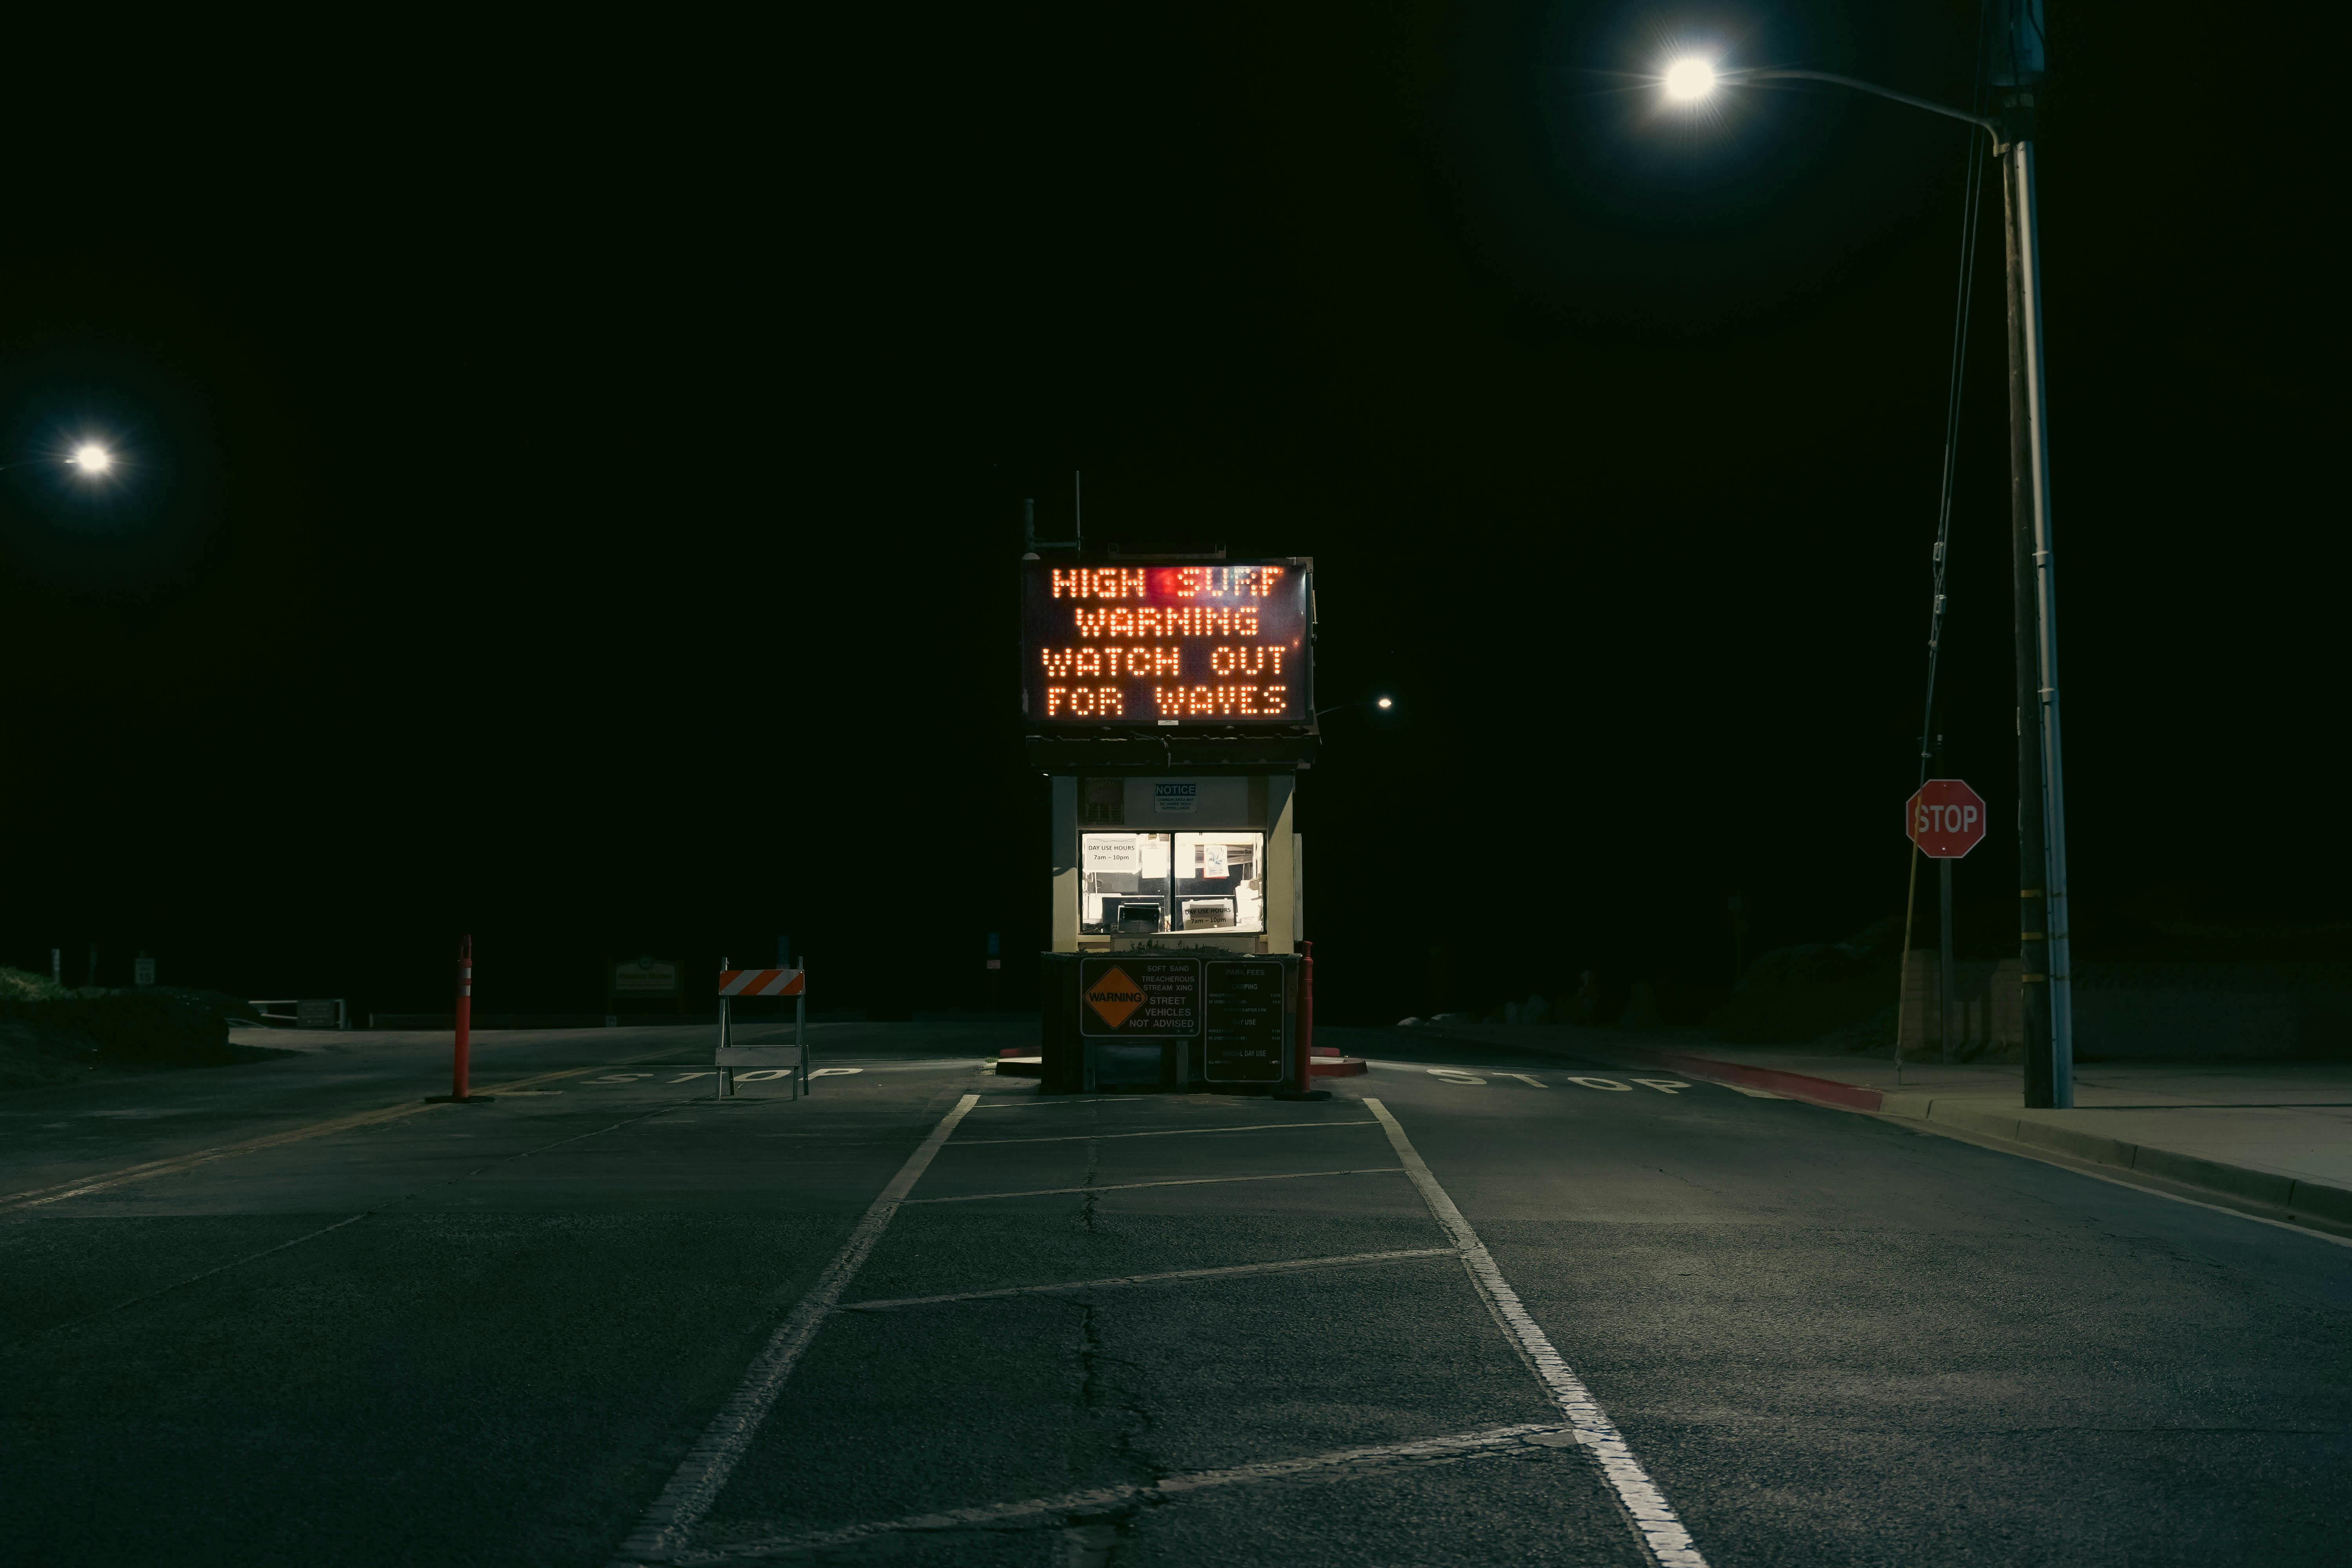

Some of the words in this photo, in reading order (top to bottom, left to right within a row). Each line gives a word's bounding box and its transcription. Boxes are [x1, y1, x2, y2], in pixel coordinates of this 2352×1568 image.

[1053, 568, 1146, 597] HIGH
[1178, 567, 1283, 597] SURF
[1075, 606, 1258, 637] WARNING
[1042, 646, 1180, 676] WATCH
[1211, 646, 1286, 675] OUT
[1048, 687, 1122, 715] FOR
[1156, 686, 1286, 715] WAVES
[1156, 785, 1195, 794] NOTICE
[1915, 805, 1977, 833] STOP
[1089, 993, 1142, 1002] WARNING
[1145, 1008, 1191, 1016] VEHICLES
[580, 1068, 864, 1085] STOP
[1427, 1069, 1694, 1094] STOP
